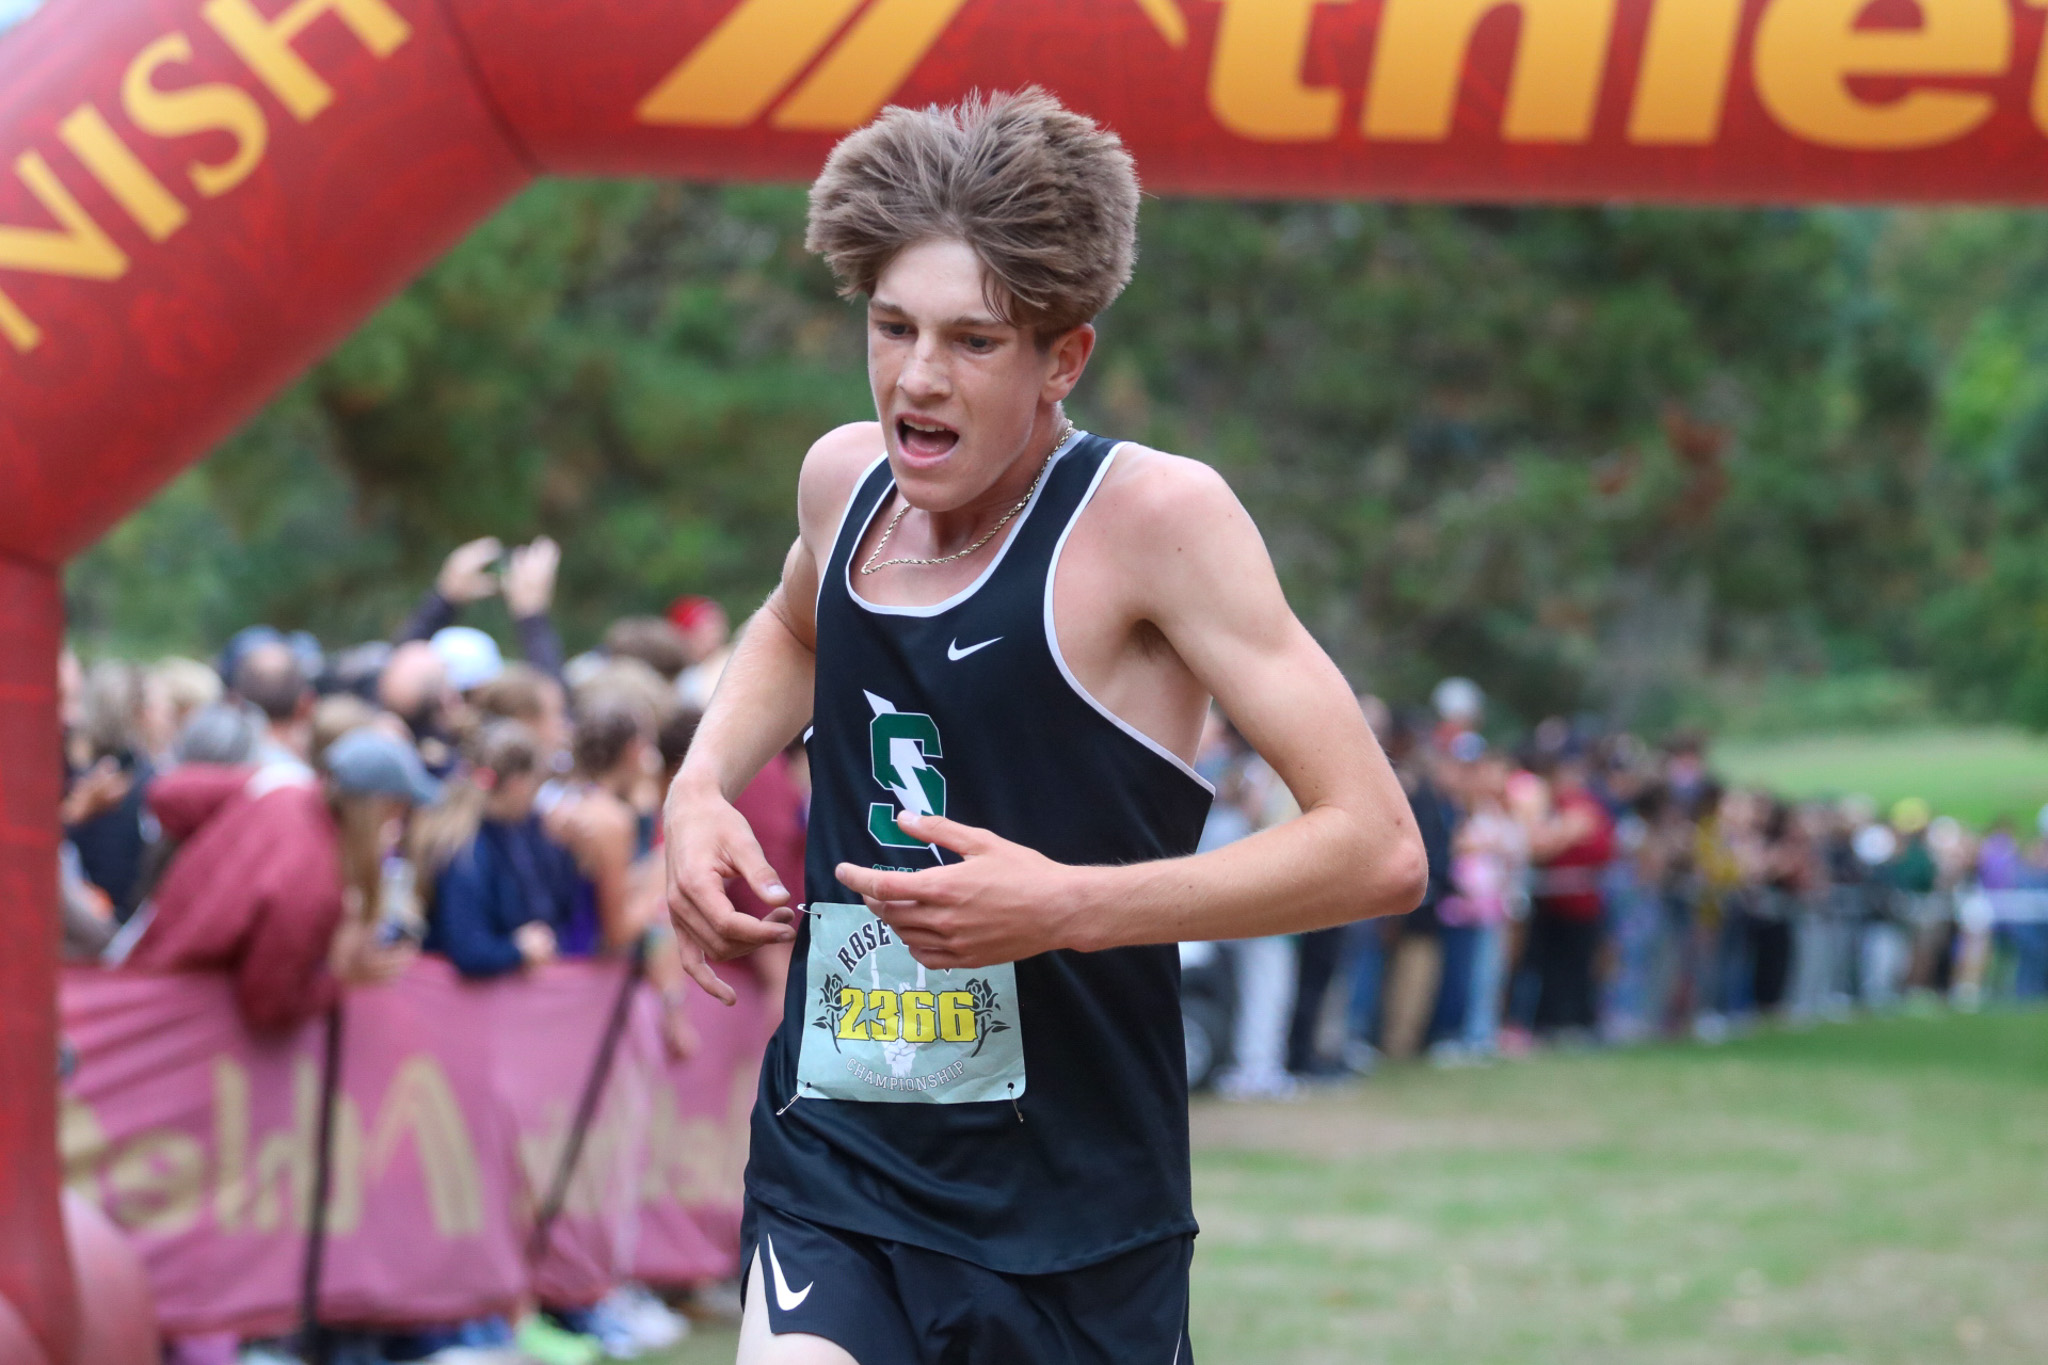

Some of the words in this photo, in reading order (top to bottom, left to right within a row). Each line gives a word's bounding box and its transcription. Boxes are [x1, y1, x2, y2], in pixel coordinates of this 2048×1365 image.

[837, 917, 892, 975] ROSE
[836, 987, 979, 1043] 2366
[846, 1057, 966, 1092] CHAMPIONSHIP
